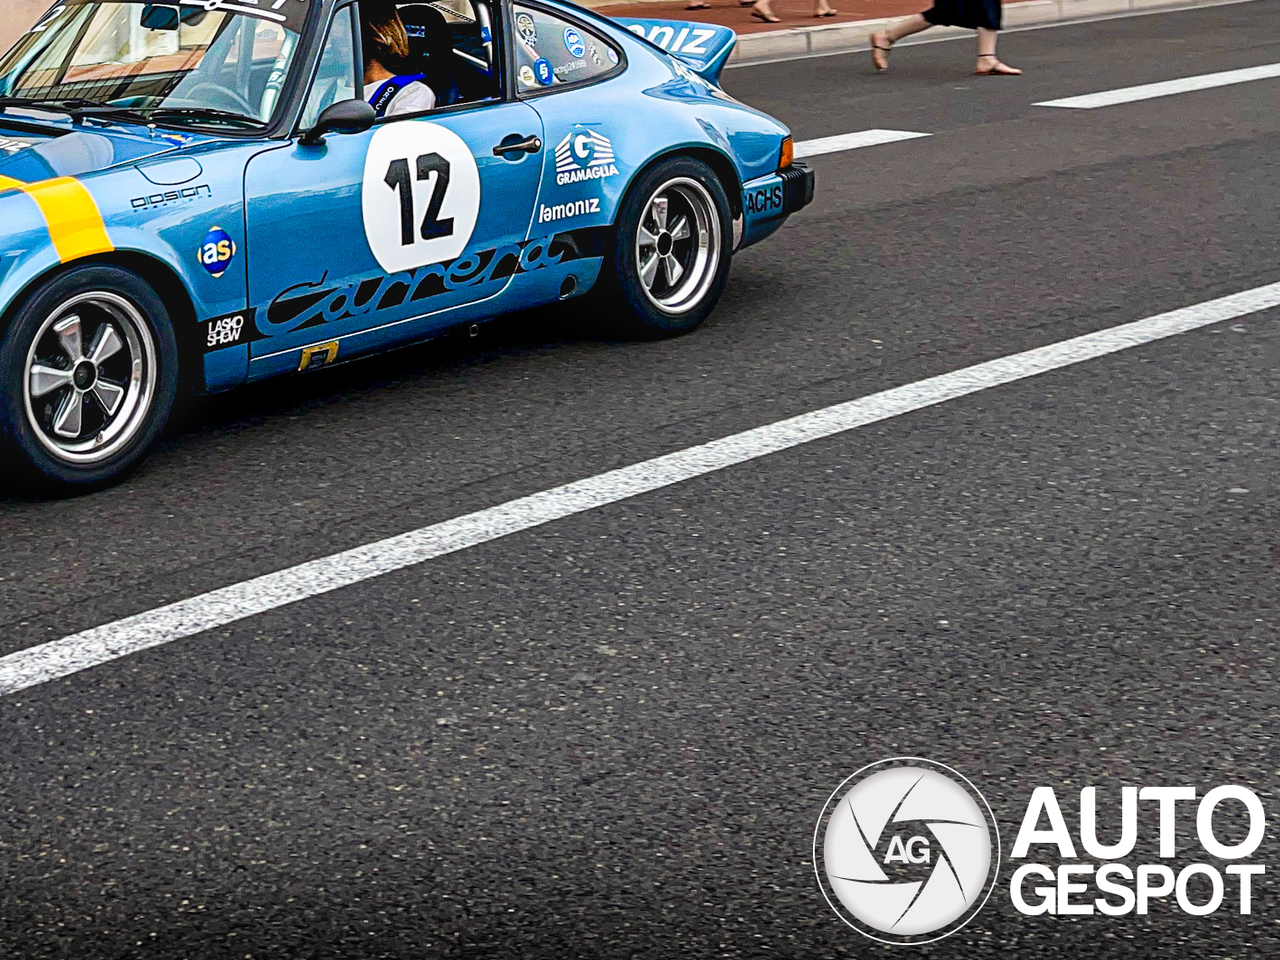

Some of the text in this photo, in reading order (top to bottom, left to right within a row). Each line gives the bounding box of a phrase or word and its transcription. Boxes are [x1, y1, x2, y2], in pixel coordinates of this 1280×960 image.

[556, 164, 620, 186] GRAMAGLIA
[384, 152, 455, 246] 12
[746, 185, 782, 215] ACHS
[203, 240, 232, 264] as
[255, 234, 570, 336] Carrera
